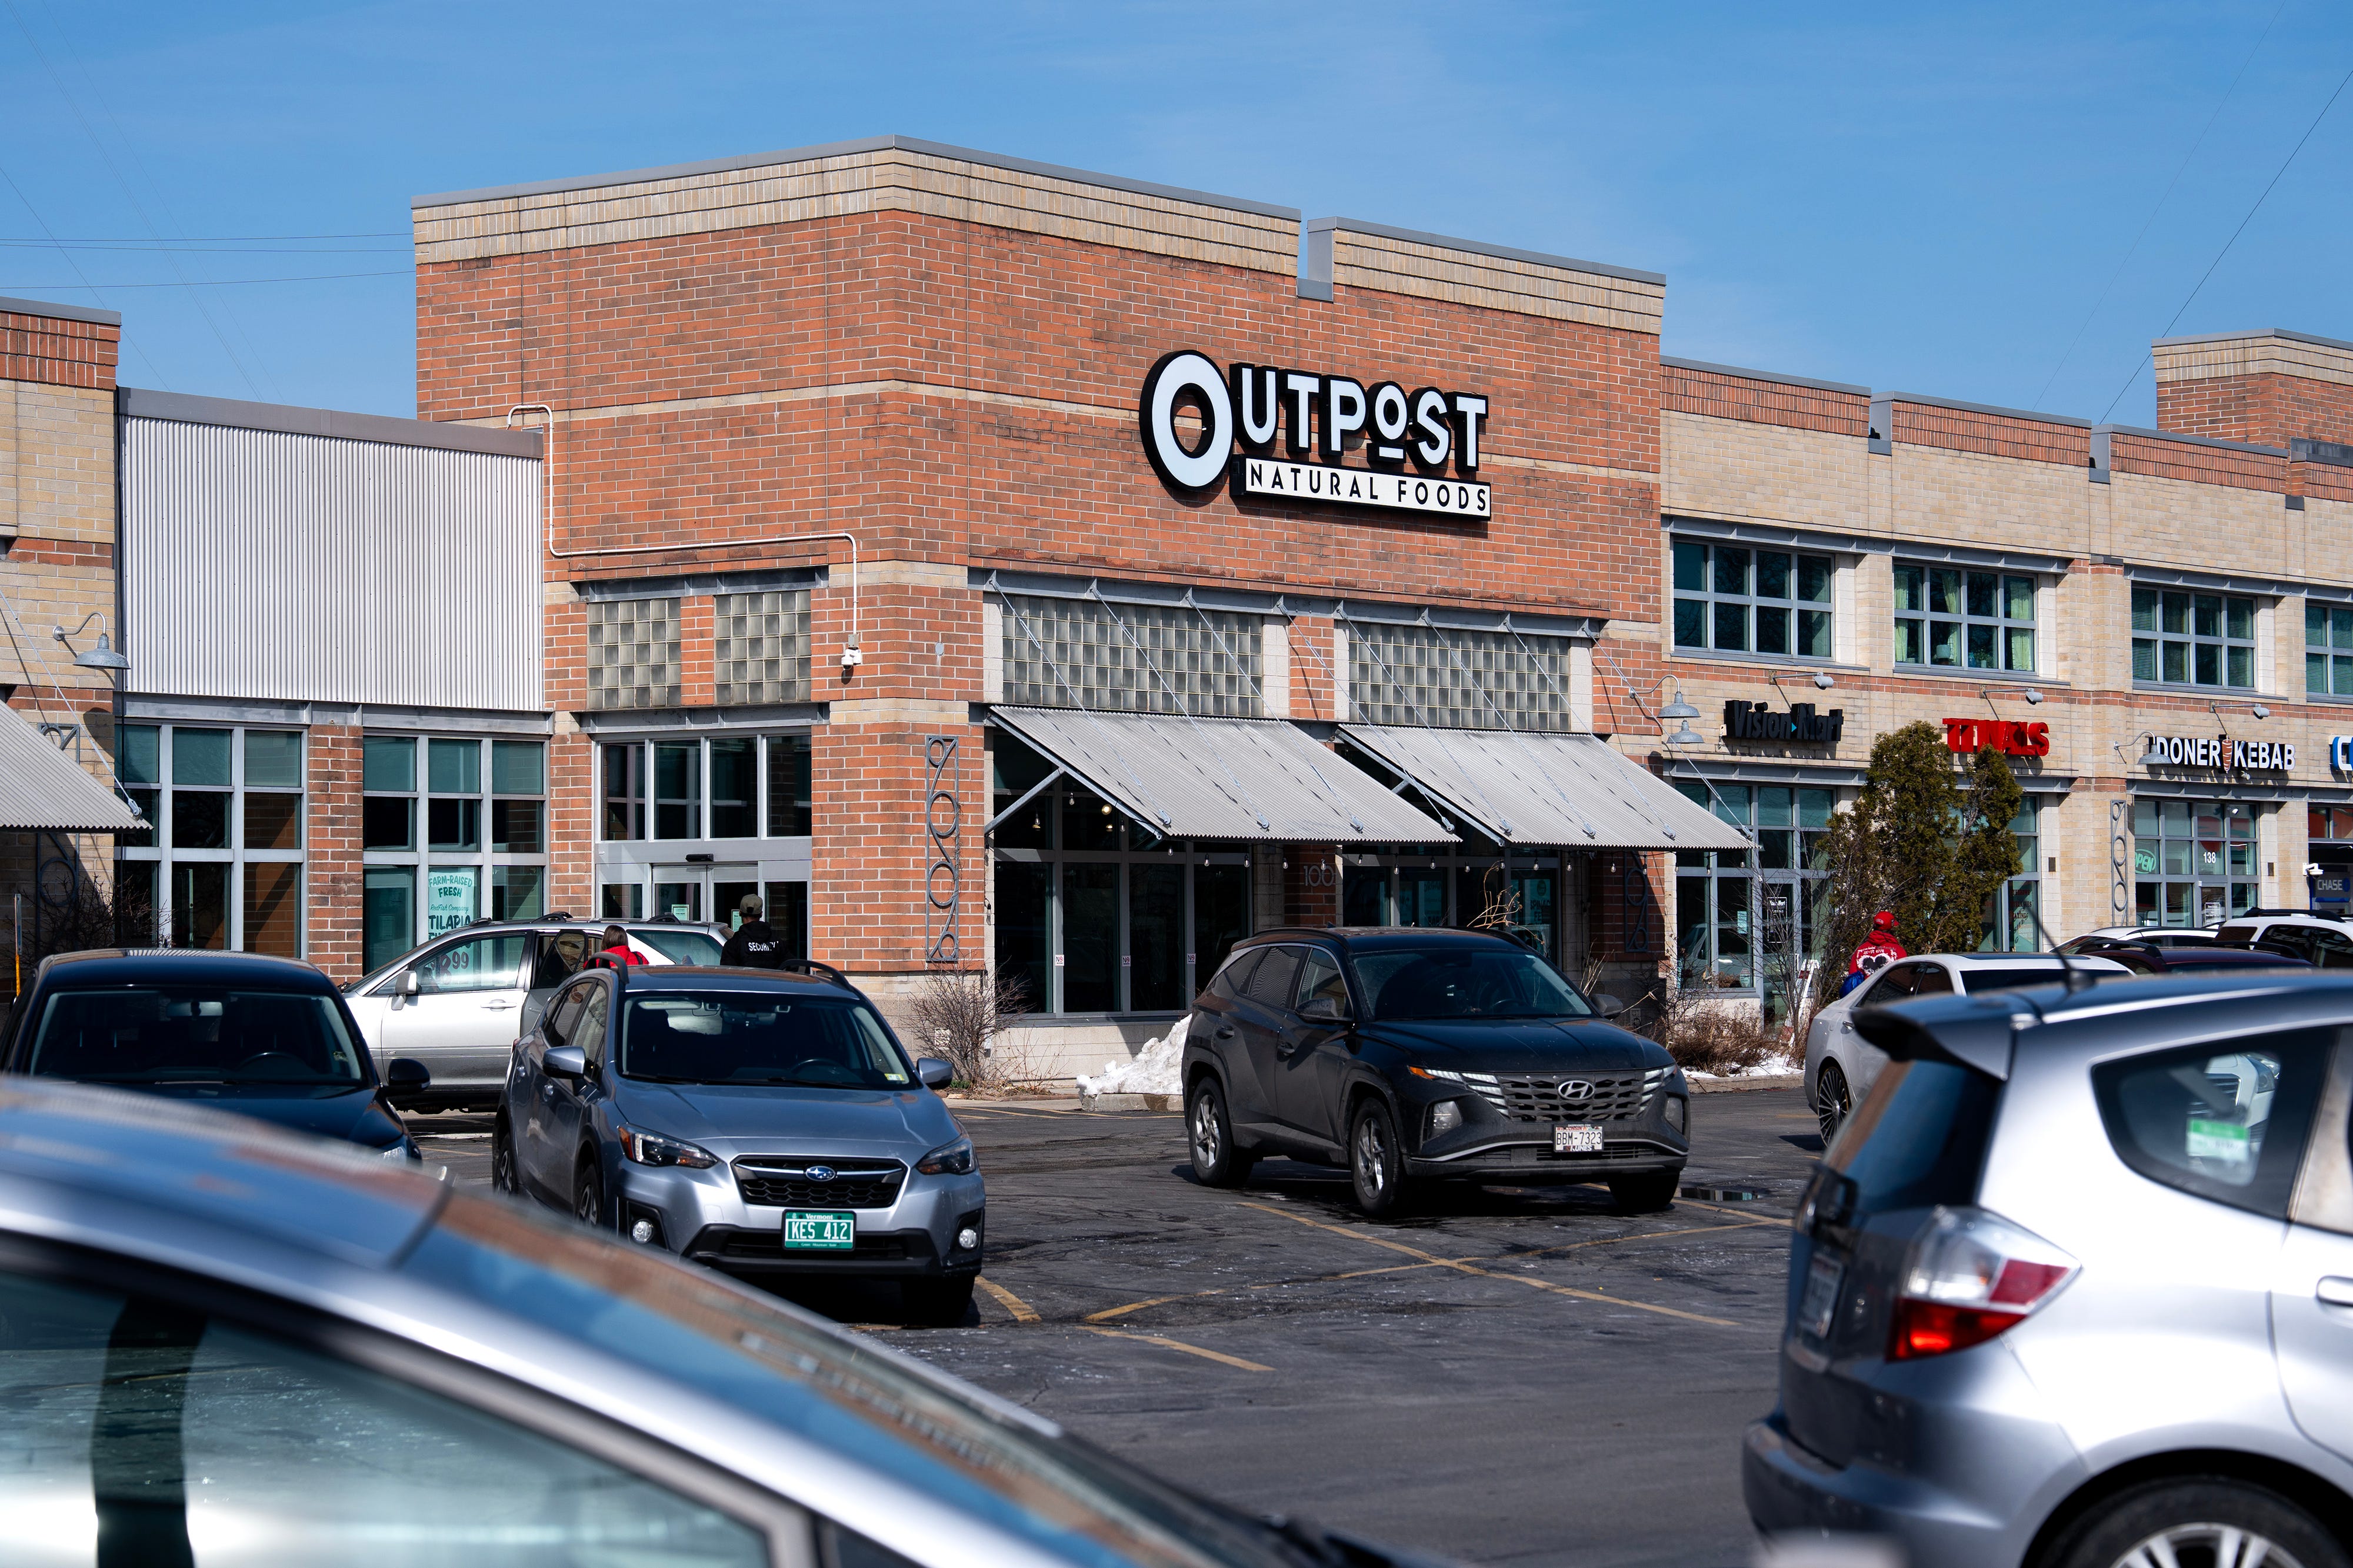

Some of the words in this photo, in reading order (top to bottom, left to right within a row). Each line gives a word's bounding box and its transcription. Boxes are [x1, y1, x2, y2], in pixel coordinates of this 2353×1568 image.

[1139, 350, 1488, 491] OUTPOST
[1251, 463, 1378, 501] NATURAL
[1398, 480, 1486, 511] FOODS
[1726, 700, 1792, 739] Vision
[1792, 703, 1844, 742] Mart
[2154, 736, 2221, 766] DONER
[2234, 740, 2295, 770] KEBAB
[2203, 852, 2216, 863] 138
[428, 875, 472, 888] FARM-RAISED
[1304, 865, 1334, 887] 100
[438, 886, 462, 898] FRESH
[2318, 879, 2343, 890] CHASE
[428, 915, 471, 930] TILAPIA
[1557, 1132, 1601, 1145] BBM-7323
[792, 1222, 815, 1239] KES
[824, 1222, 848, 1239] 412
